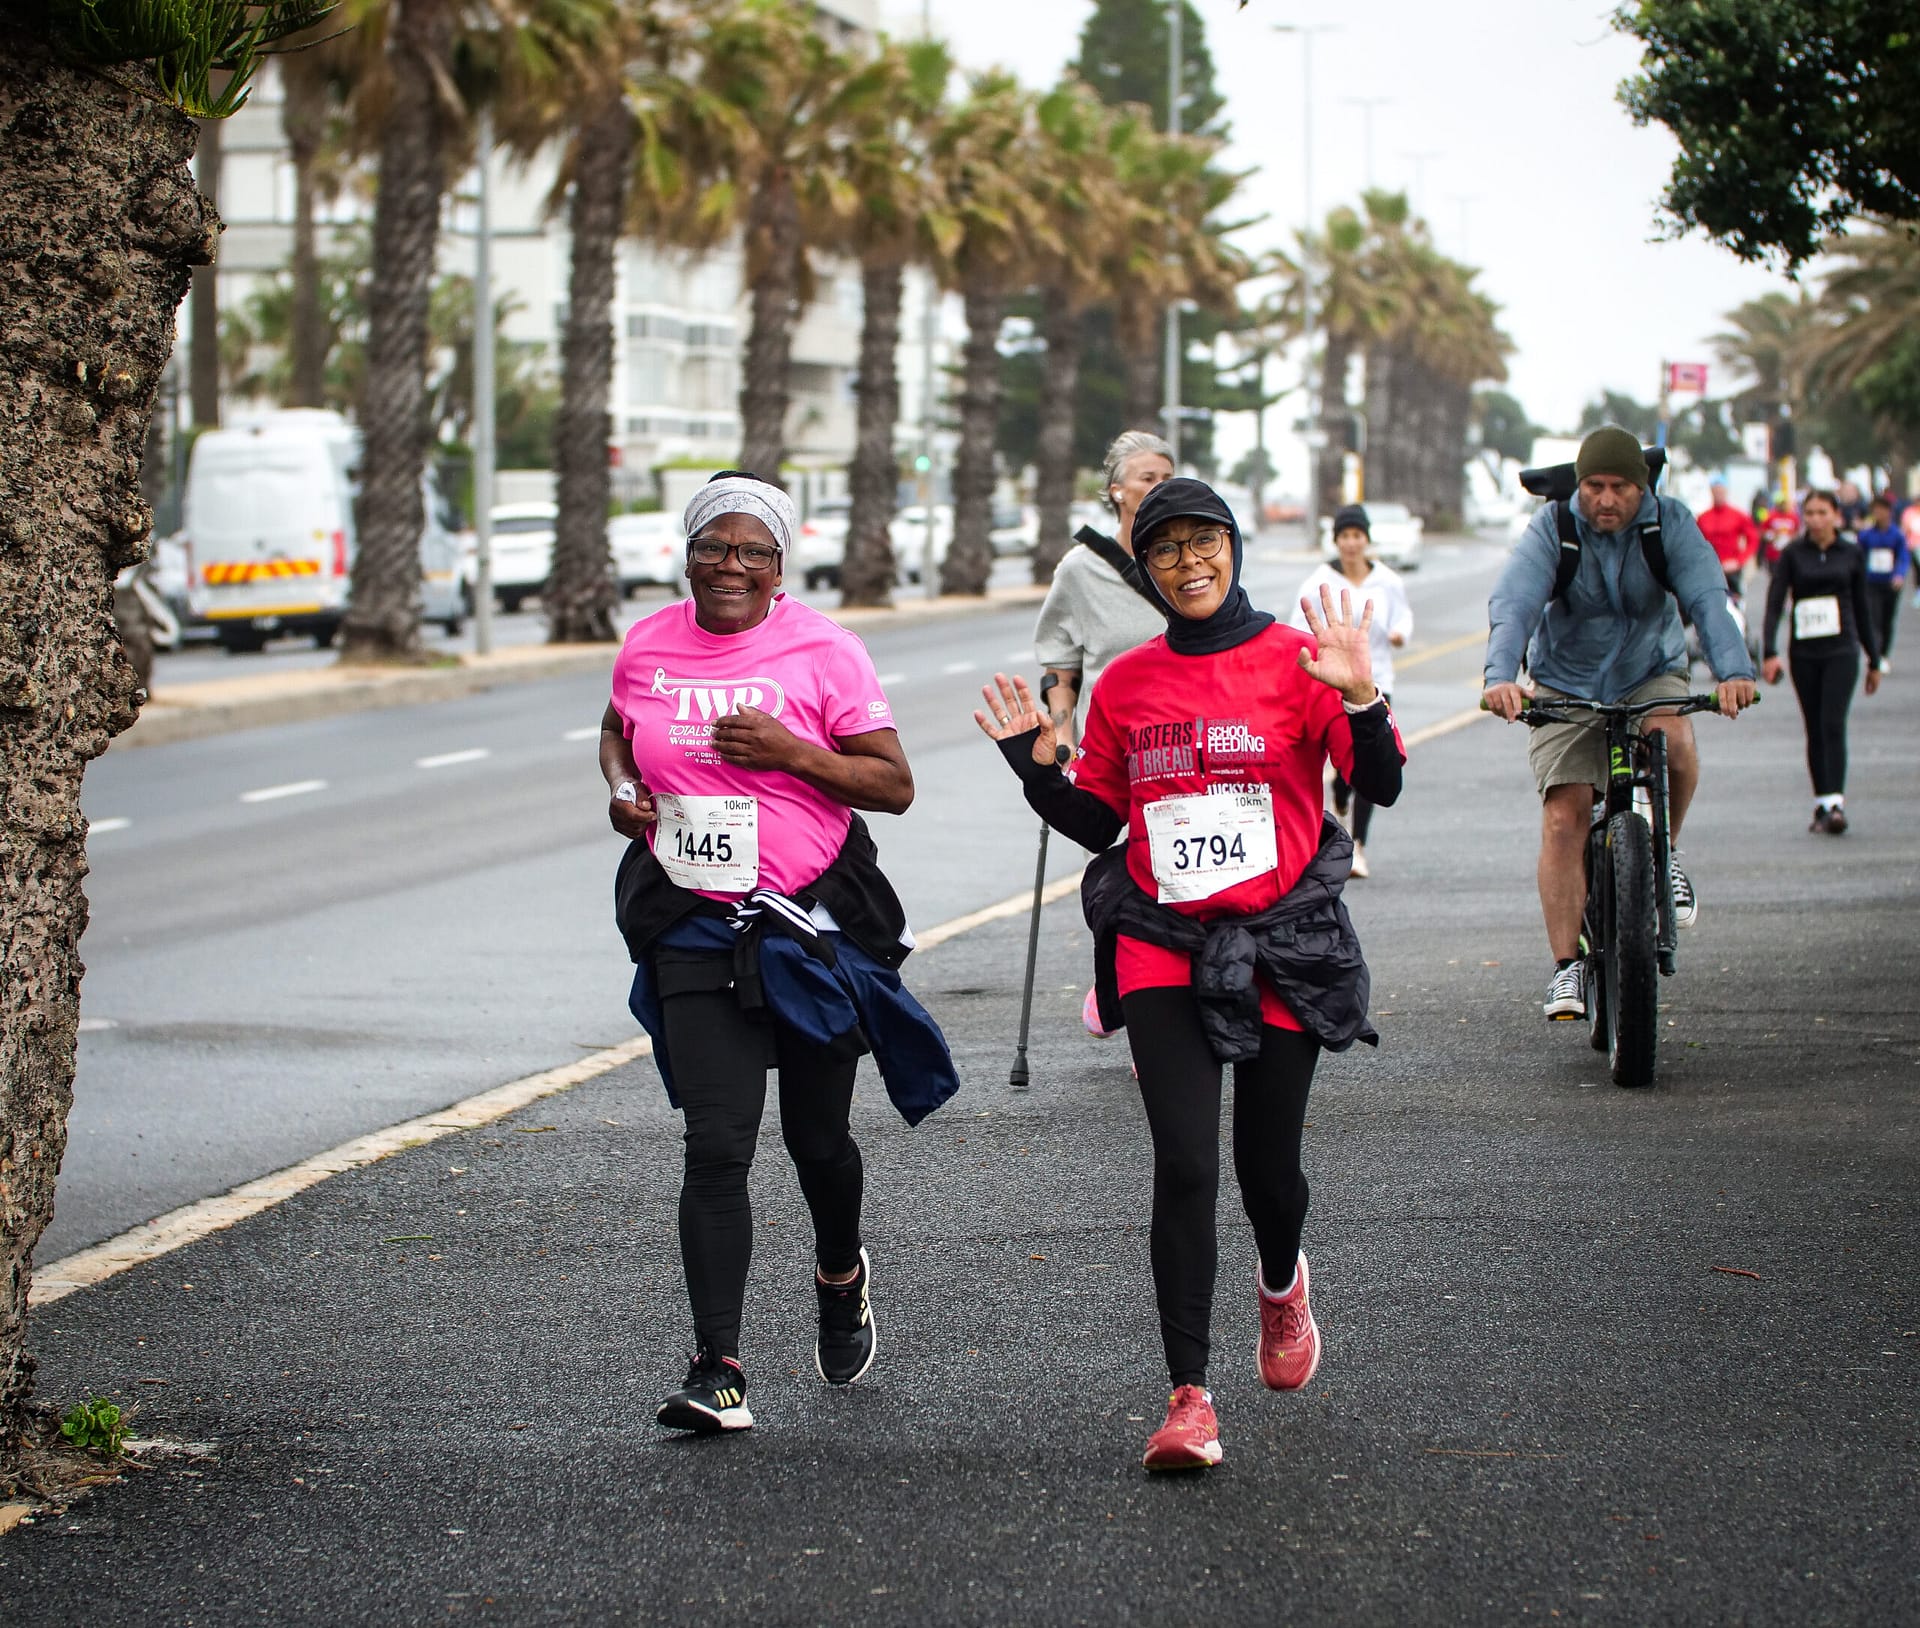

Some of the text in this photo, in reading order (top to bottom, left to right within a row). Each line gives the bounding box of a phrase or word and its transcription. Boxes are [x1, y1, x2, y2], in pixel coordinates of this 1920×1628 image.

[1207, 726, 1249, 739] SCHOOL
[1207, 736, 1265, 753] FEEDING
[1143, 745, 1194, 775] BREAD
[724, 799, 750, 810] 10km
[1234, 796, 1263, 807] 10km
[675, 828, 732, 862] 1445
[1173, 833, 1246, 869] 3794
